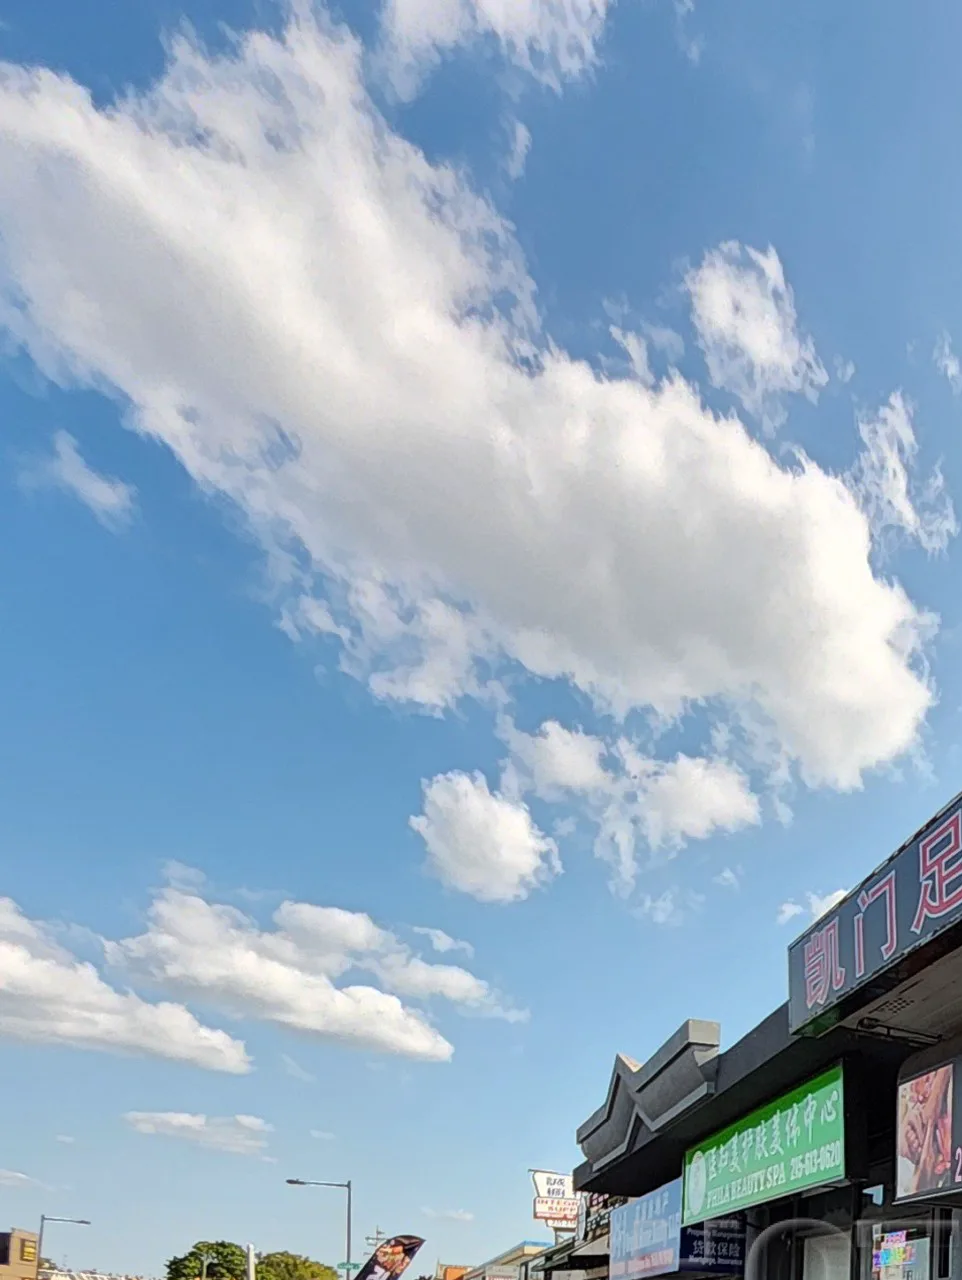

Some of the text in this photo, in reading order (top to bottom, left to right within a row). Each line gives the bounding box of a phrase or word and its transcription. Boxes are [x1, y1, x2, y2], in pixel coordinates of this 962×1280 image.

[706, 1185, 730, 1209] PHILA
[731, 1168, 766, 1202] BEAUTY
[766, 1162, 787, 1190] SPA
